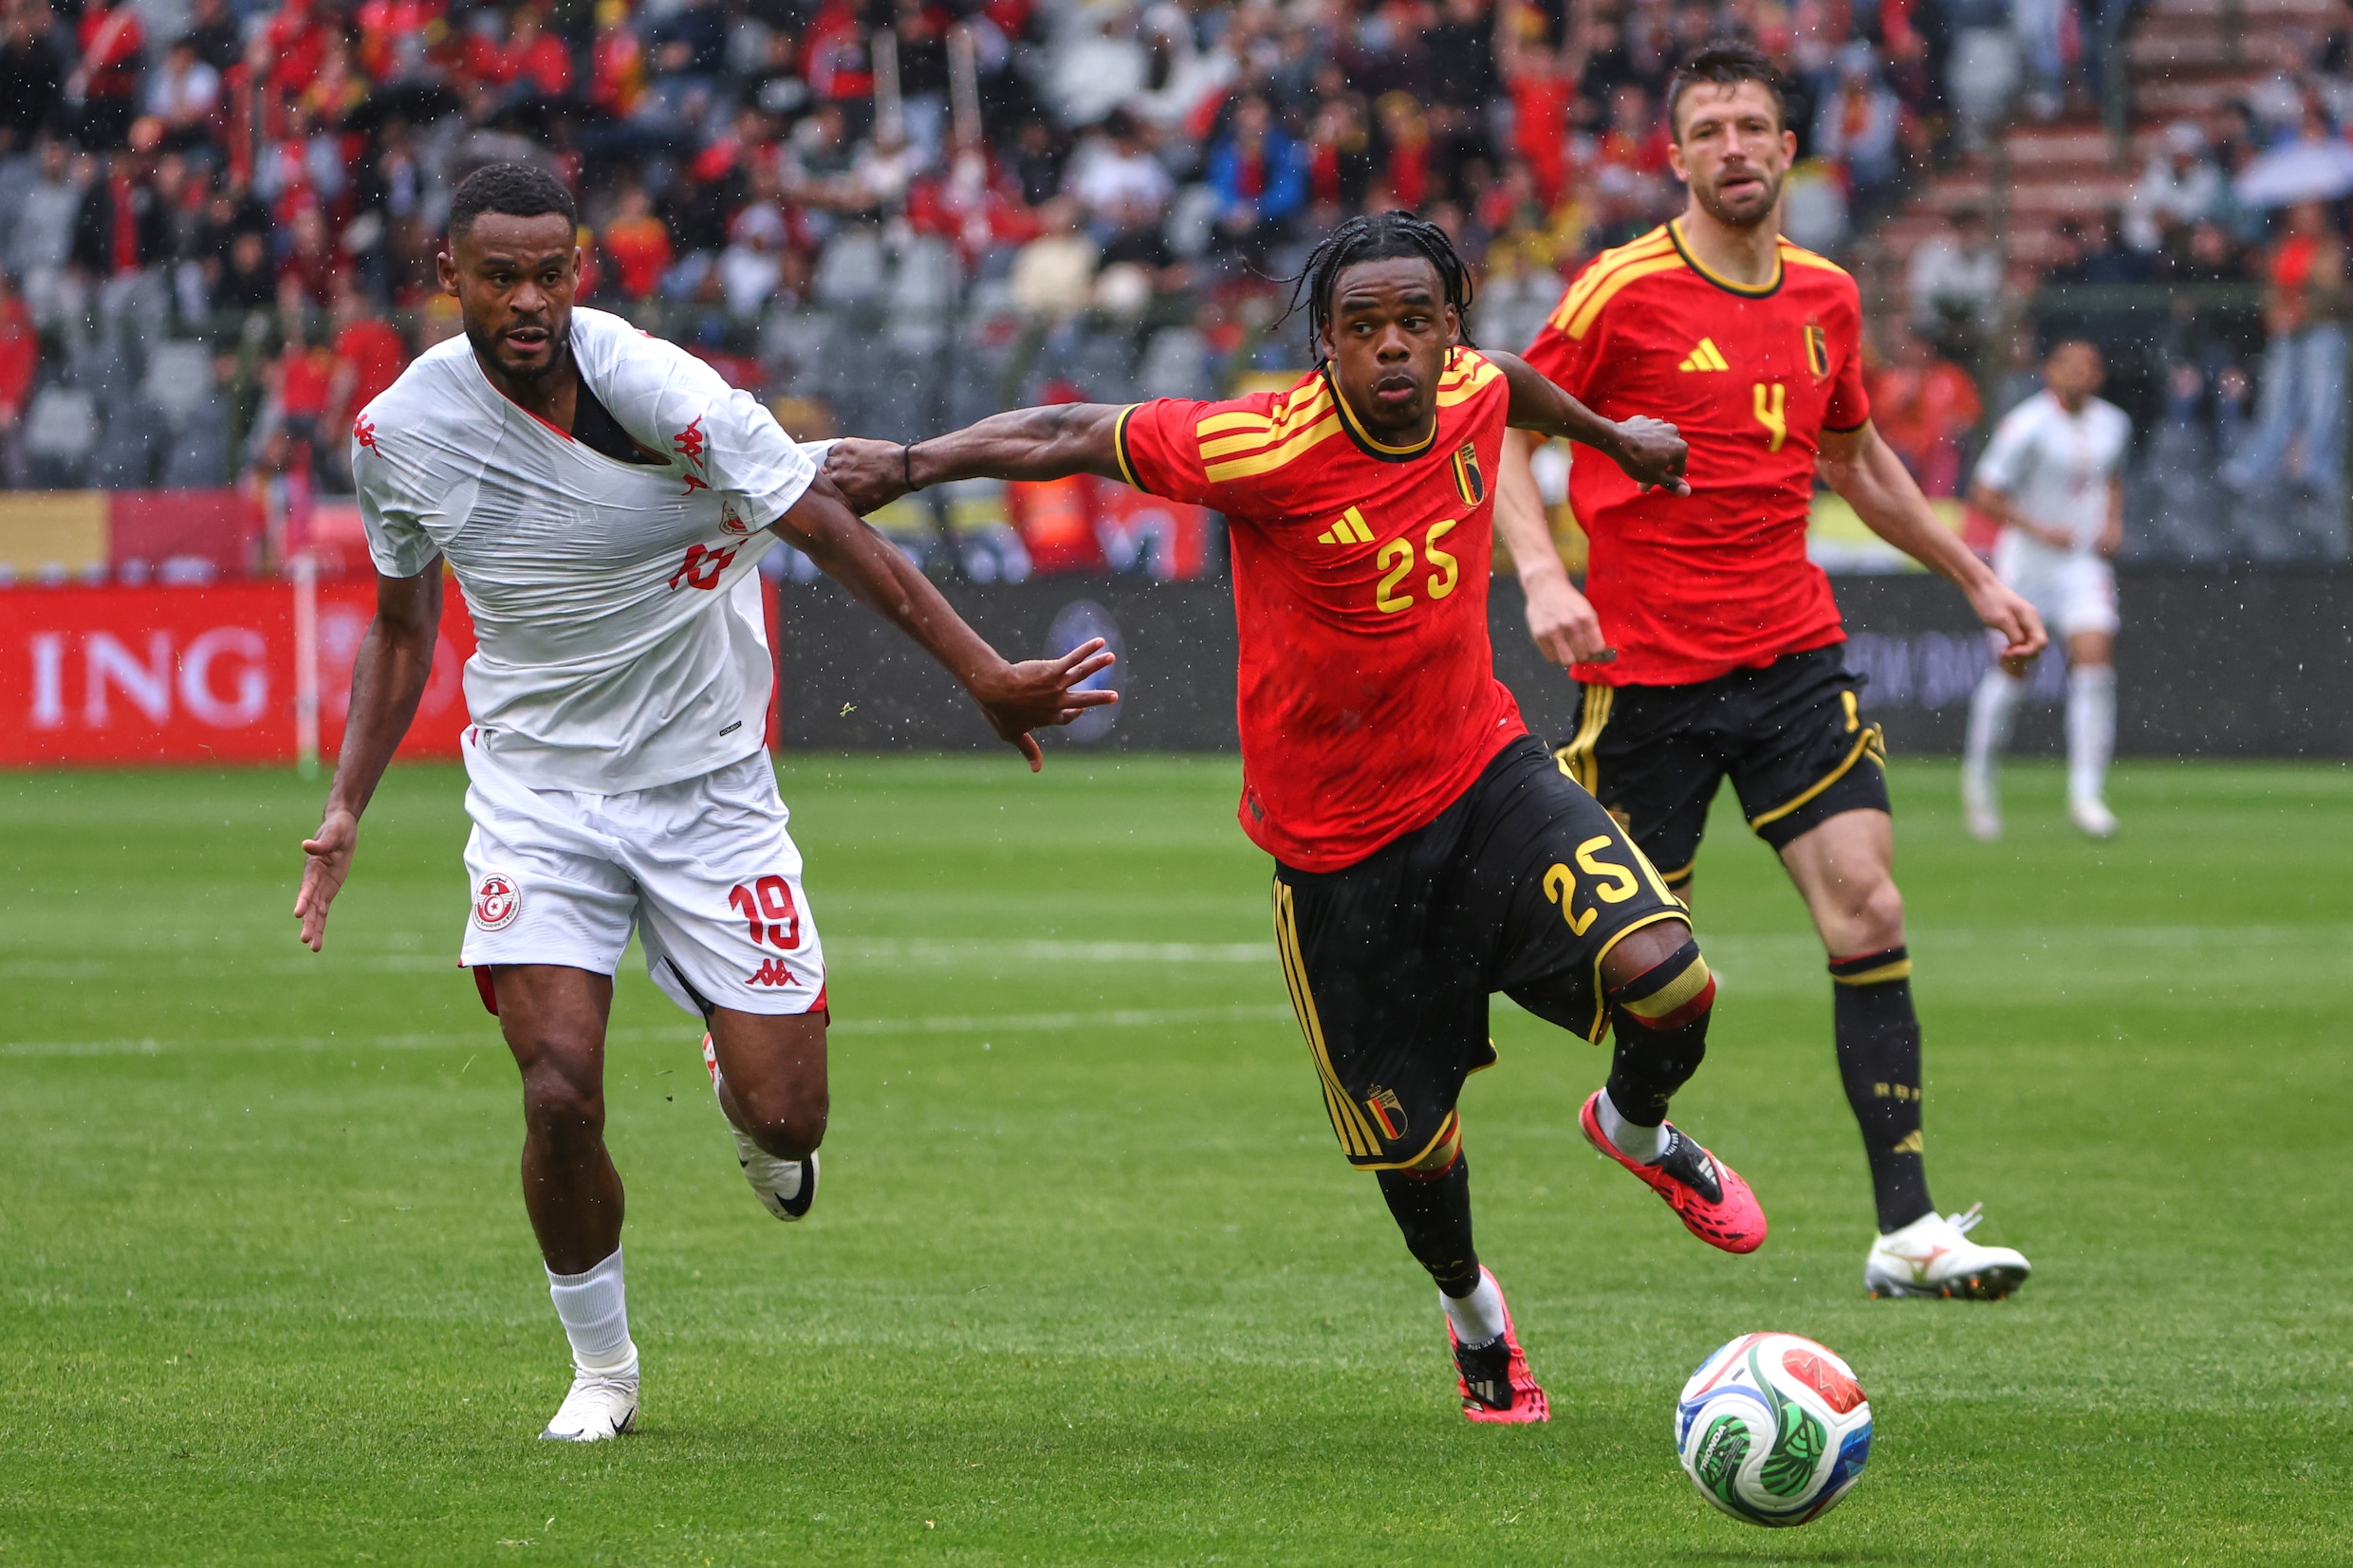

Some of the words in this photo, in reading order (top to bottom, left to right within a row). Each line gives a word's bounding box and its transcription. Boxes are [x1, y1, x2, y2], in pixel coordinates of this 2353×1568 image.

[1753, 383, 1787, 453] 4
[1376, 519, 1459, 614] 25
[29, 627, 269, 729] ING
[728, 875, 800, 950] 19
[1543, 835, 1640, 936] 25
[1699, 1425, 1727, 1472] TRIONDA
